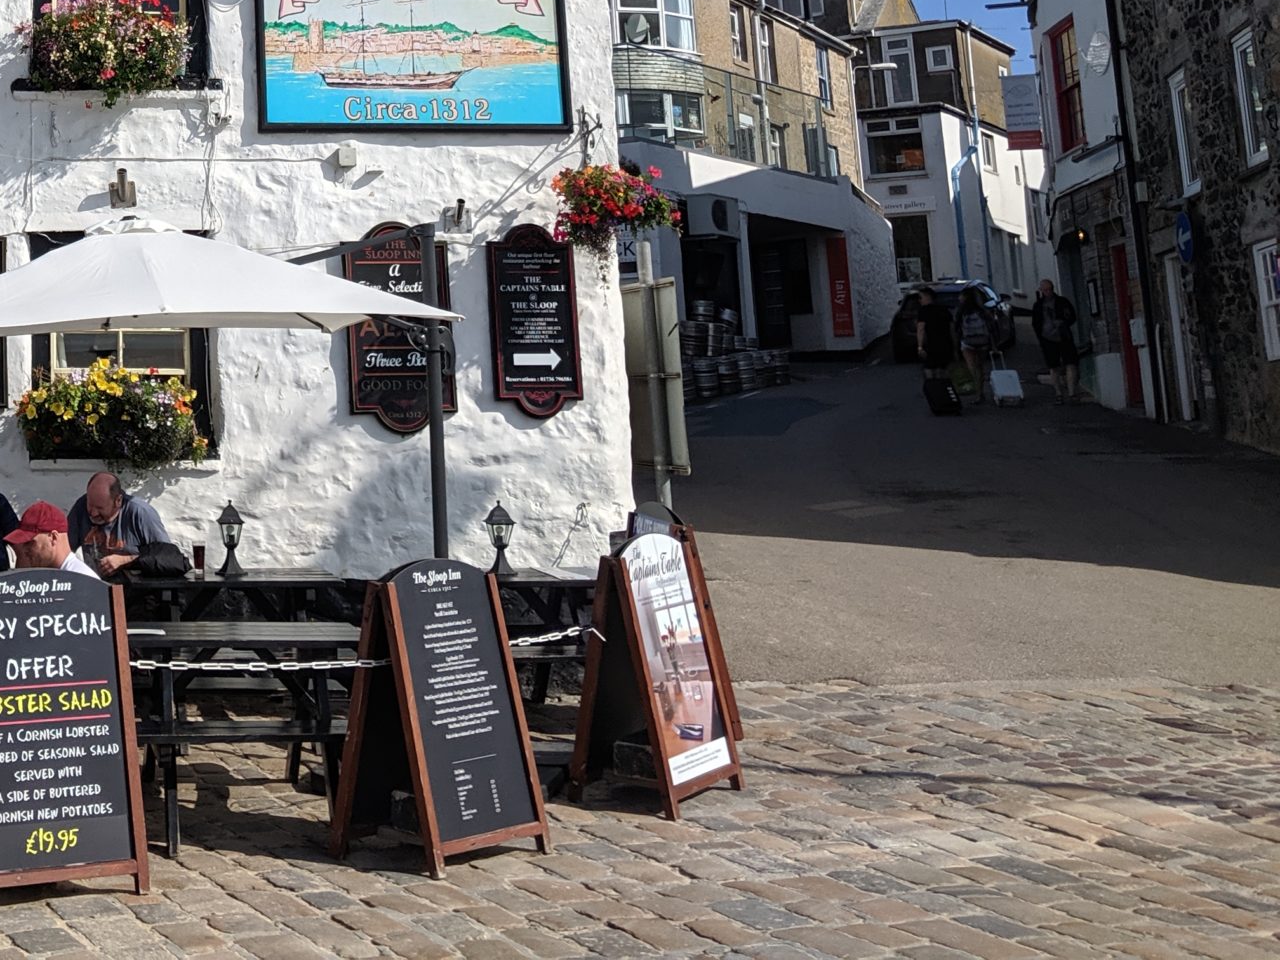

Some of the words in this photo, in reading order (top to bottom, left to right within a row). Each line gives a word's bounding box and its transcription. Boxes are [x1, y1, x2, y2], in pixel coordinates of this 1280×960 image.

[385, 241, 406, 249] THE
[365, 250, 401, 259] SLOOP
[387, 280, 424, 293] Selecti
[500, 284, 540, 292] CAPTAINS
[541, 284, 567, 292] TABLE
[524, 276, 542, 284] THE
[511, 302, 529, 310] THE
[530, 302, 559, 310] SLOOP
[365, 353, 403, 367] Three
[361, 380, 402, 391] GOOD
[426, 569, 448, 586] Sloop
[15, 580, 49, 598] Sloop
[51, 579, 72, 592] Inn
[25, 612, 112, 638] SPECIAL
[6, 655, 74, 680] OFFER
[58, 688, 113, 711] SALAD
[7, 732, 14, 744] A
[16, 728, 63, 743] CORNISH
[65, 724, 111, 738] LOBSTER
[0, 751, 19, 764] BED
[21, 750, 35, 762] OF
[37, 747, 87, 760] SEASONAL
[89, 743, 120, 756] SALAD
[14, 768, 55, 782] SERVED
[58, 765, 82, 779] WITH
[7, 789, 31, 803] SIDE
[33, 789, 46, 800] OF
[49, 784, 102, 799] BUTTERED
[37, 807, 59, 820] NEW
[62, 802, 113, 818] POTATOES
[25, 827, 80, 855] £19.95
